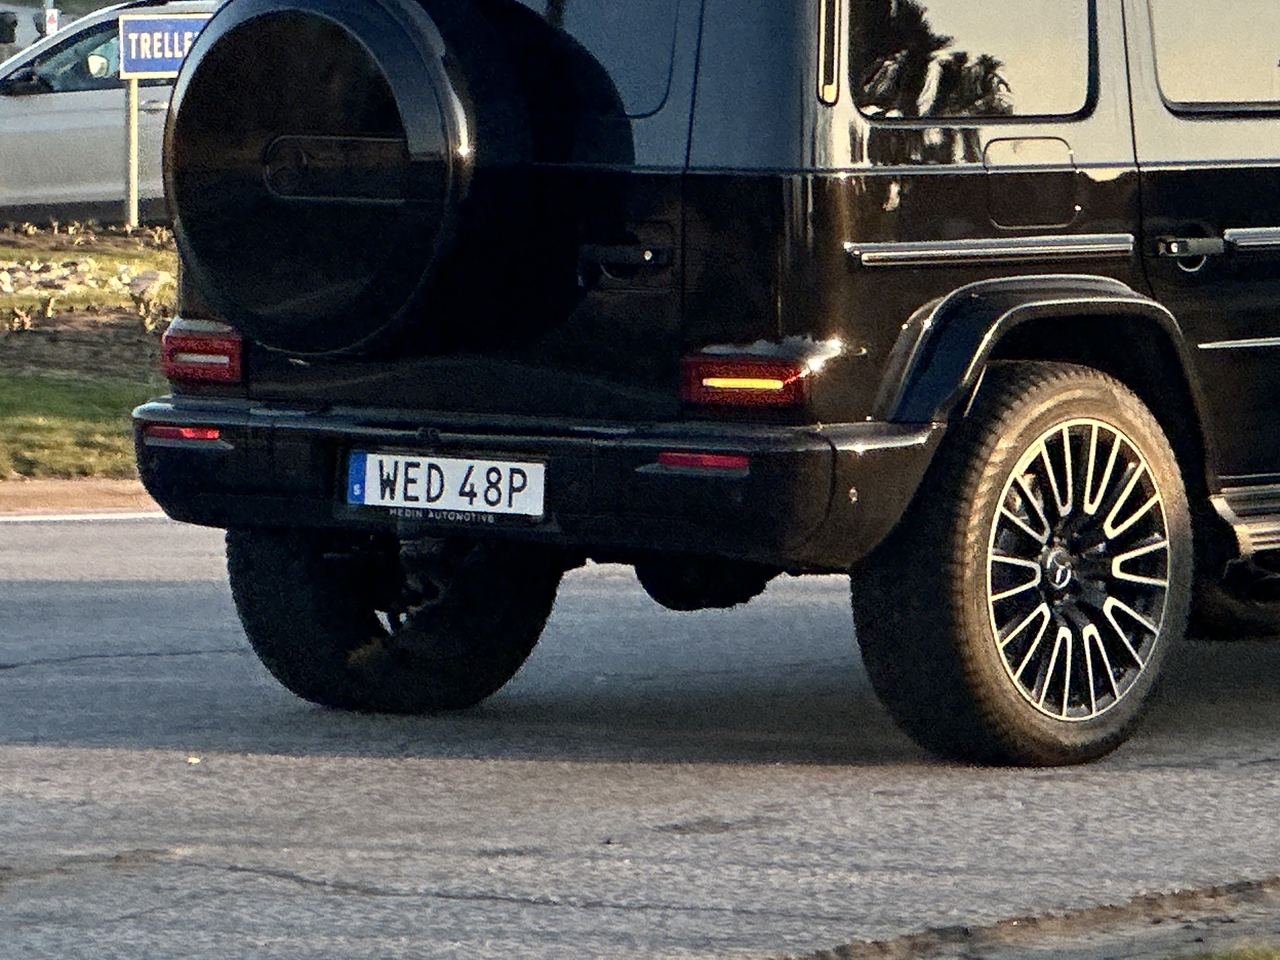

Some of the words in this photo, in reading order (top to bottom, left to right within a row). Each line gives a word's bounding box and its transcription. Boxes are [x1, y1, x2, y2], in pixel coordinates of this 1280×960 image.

[128, 32, 200, 59] TRELLE
[378, 459, 444, 503] WED
[459, 465, 528, 507] 48P
